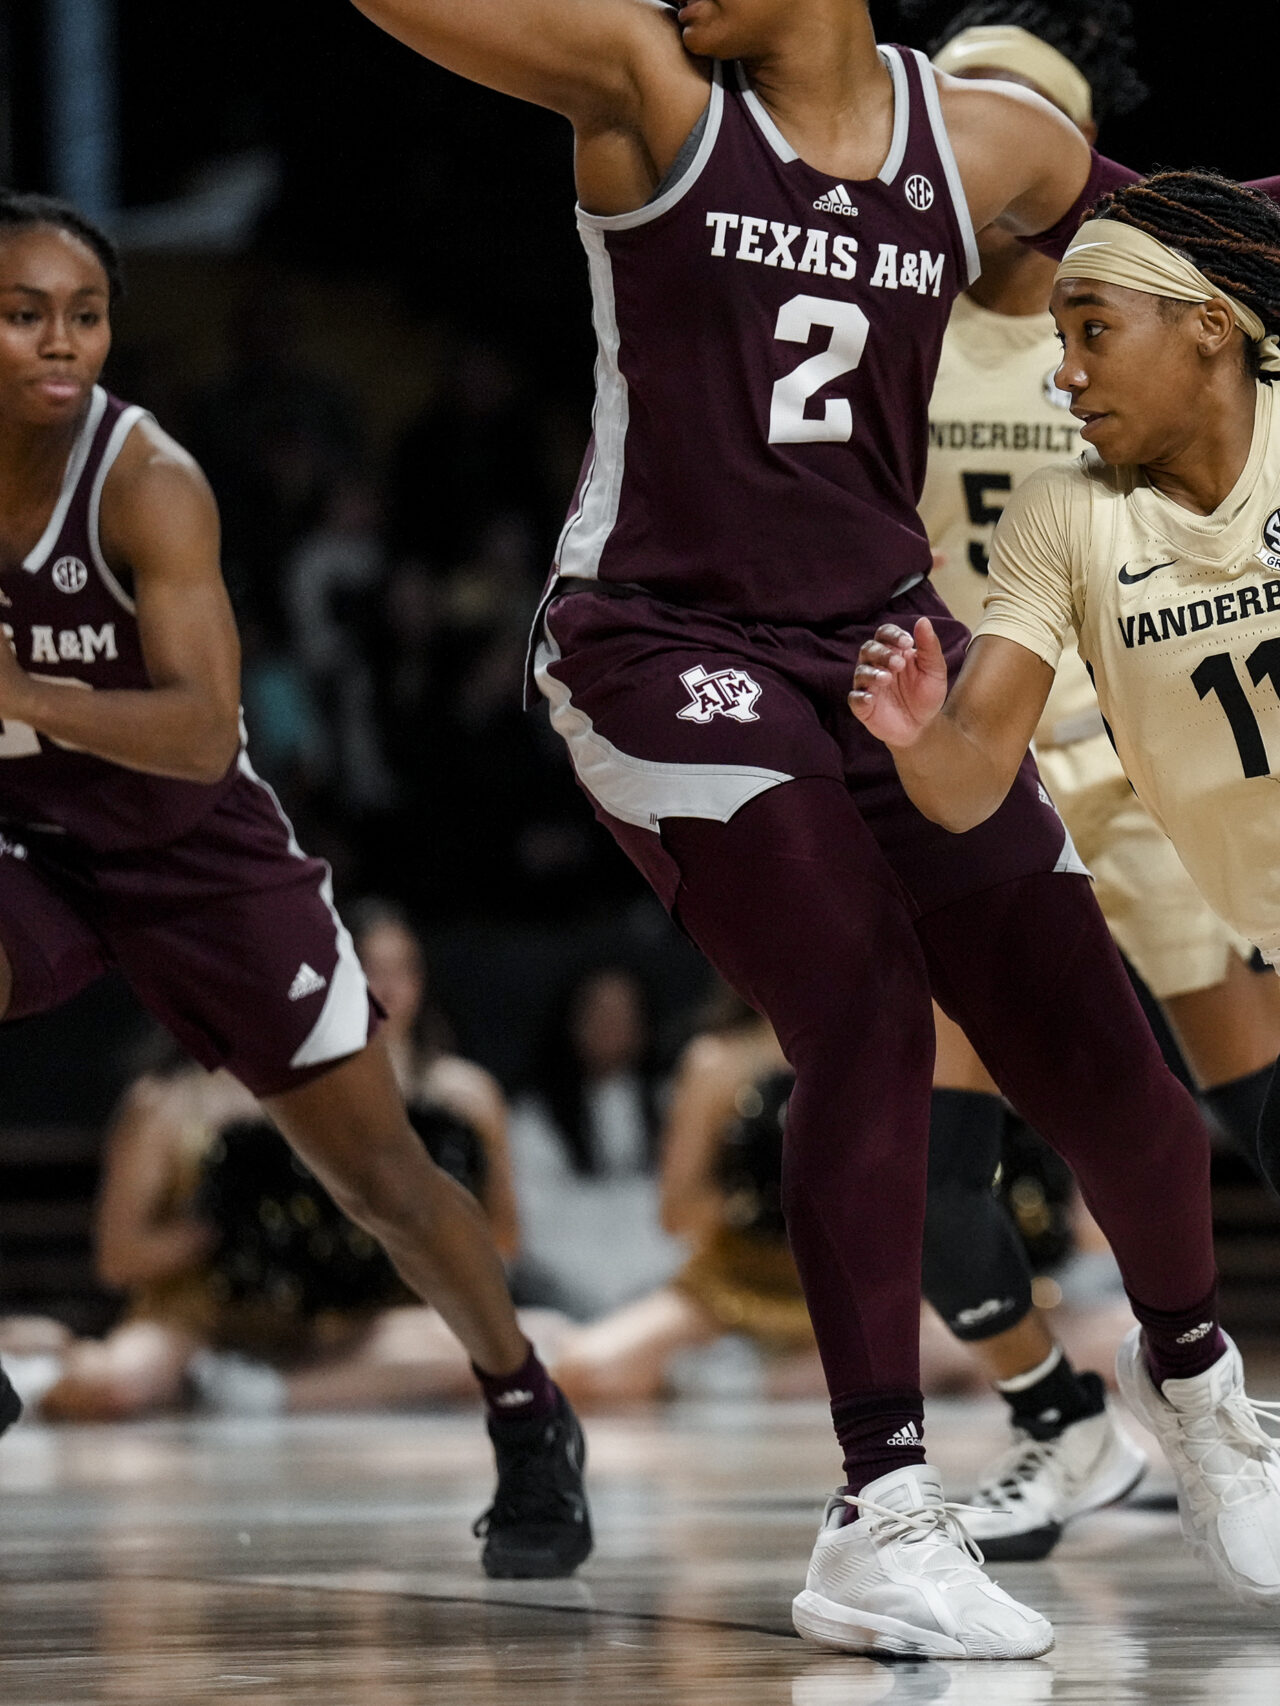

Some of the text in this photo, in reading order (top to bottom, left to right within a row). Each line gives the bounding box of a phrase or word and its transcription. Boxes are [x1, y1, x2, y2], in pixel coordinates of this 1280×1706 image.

[812, 199, 859, 217] adidas
[906, 176, 932, 209] SEC
[705, 211, 945, 298] TEXAS A&M
[768, 293, 870, 444] 2
[961, 471, 1012, 577] 5
[31, 622, 118, 664] A&M
